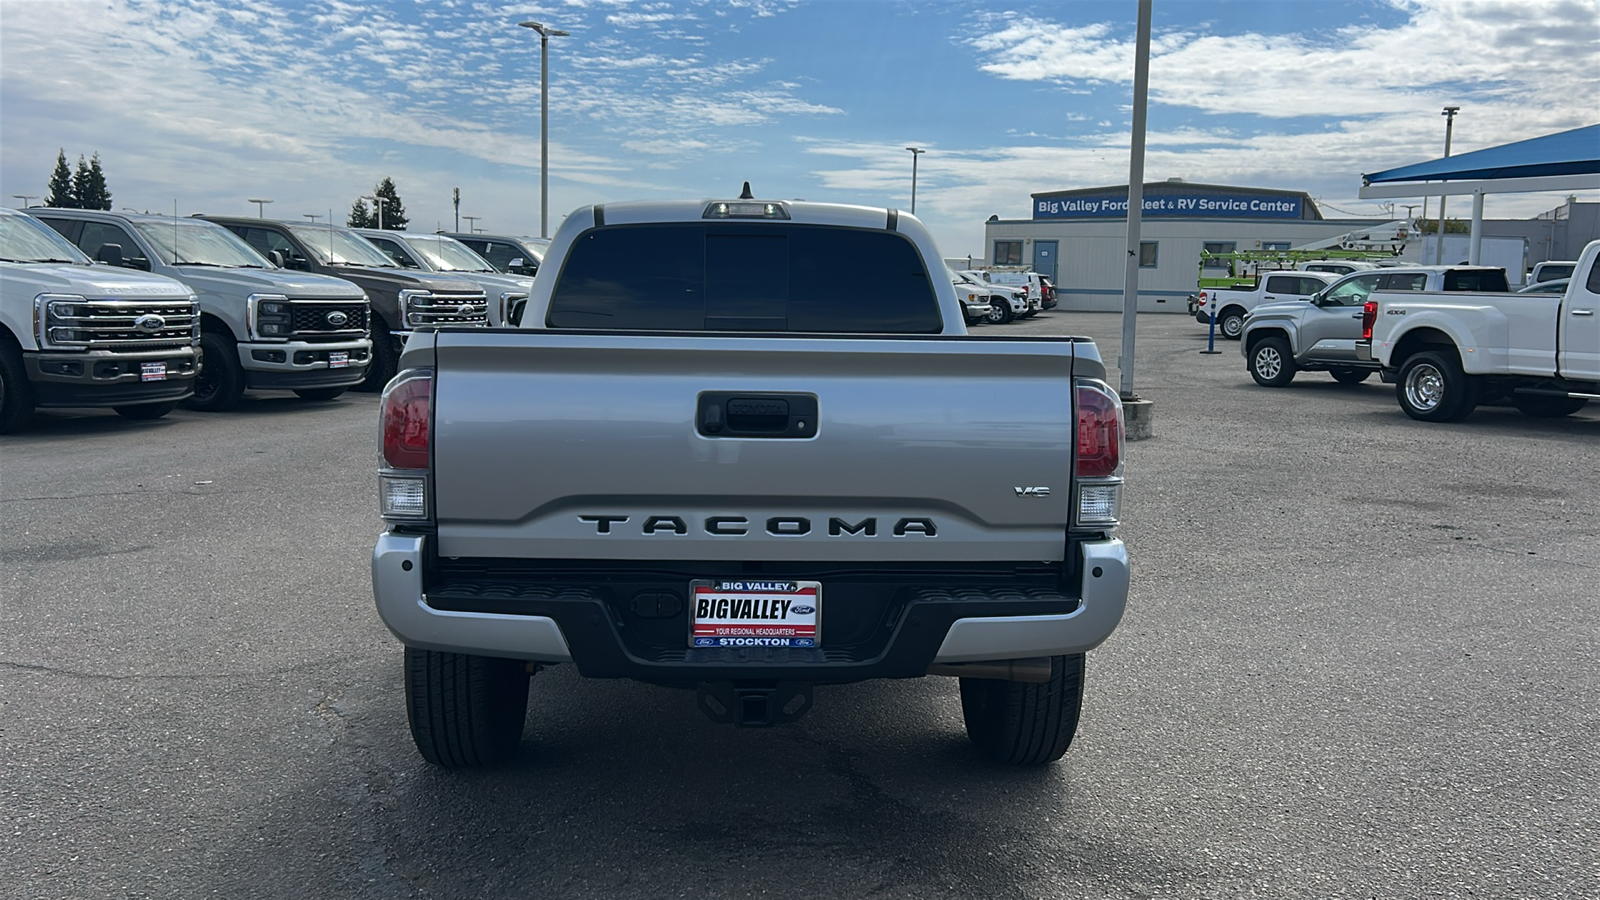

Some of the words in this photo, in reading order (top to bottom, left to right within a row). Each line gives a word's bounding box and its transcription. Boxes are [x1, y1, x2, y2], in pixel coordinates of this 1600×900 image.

[1038, 201, 1058, 213] Big
[1061, 201, 1099, 213] Valley
[1101, 200, 1129, 210] Ford
[1141, 199, 1165, 209] leet
[1167, 201, 1175, 209] &
[1177, 199, 1197, 209] RV
[1198, 199, 1248, 211] Service
[1250, 200, 1296, 212] Center
[1013, 486, 1051, 498] V6
[577, 515, 938, 537] TACOMA
[722, 582, 743, 590] BIG
[746, 582, 790, 590] VALLEY
[696, 598, 792, 620] BIGVALLEY
[793, 604, 812, 614] Ford
[756, 628, 795, 636] HEADQUARTERS
[719, 638, 790, 646] STOCKTON
